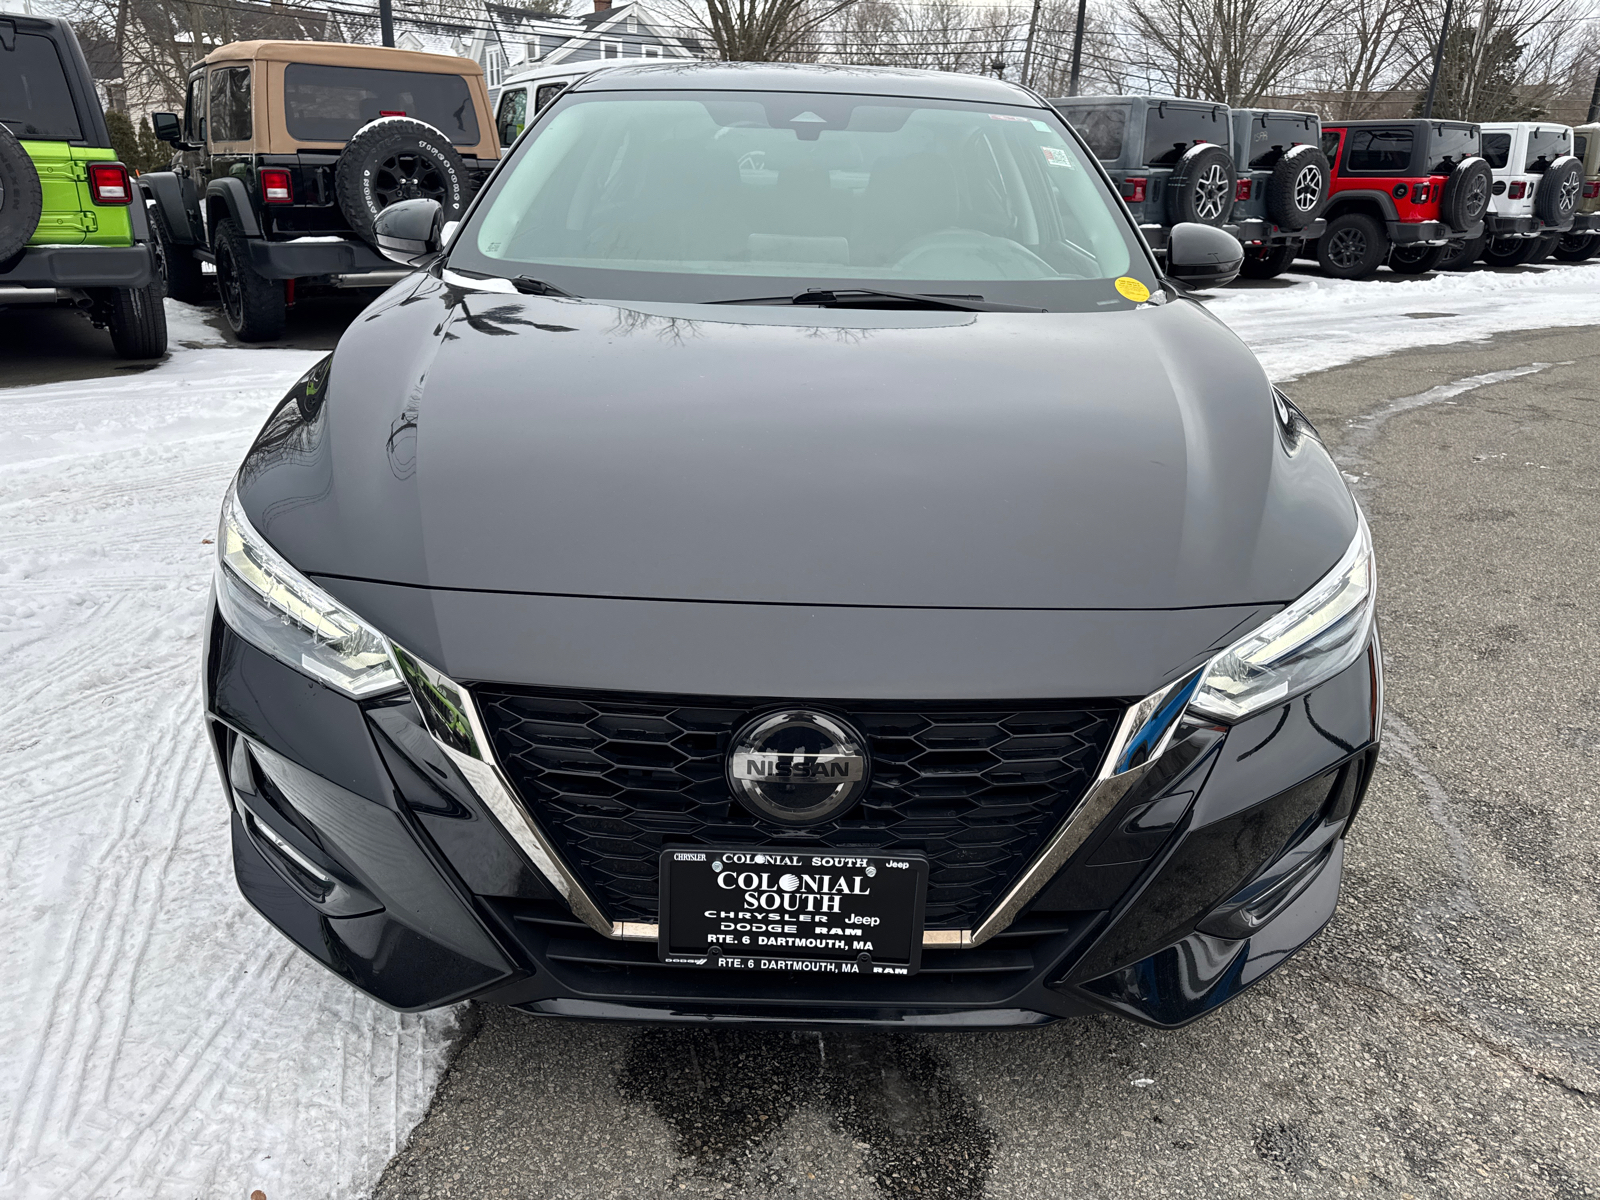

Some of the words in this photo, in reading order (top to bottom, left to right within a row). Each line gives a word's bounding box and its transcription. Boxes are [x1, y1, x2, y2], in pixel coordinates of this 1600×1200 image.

[746, 759, 849, 777] NISSAN
[674, 853, 706, 862] CHRYSLER
[722, 854, 801, 865] COLONIAL
[812, 857, 867, 867] SOUTH
[886, 861, 909, 869] Jeep
[717, 872, 870, 895] COLONIAL
[744, 892, 842, 912] SOUTH
[704, 911, 828, 922] CHRYSLER
[845, 914, 880, 926] Jeep
[721, 922, 797, 933] DODGE
[815, 927, 862, 936] RAM
[708, 934, 738, 944] RTE.
[742, 936, 750, 944] 6
[759, 936, 848, 950] DARTMOUTH,
[853, 941, 873, 950] MA
[718, 958, 744, 968] RTE.
[748, 960, 754, 968] 6
[761, 960, 838, 973] DARTMOUTH,
[842, 964, 859, 973] MA
